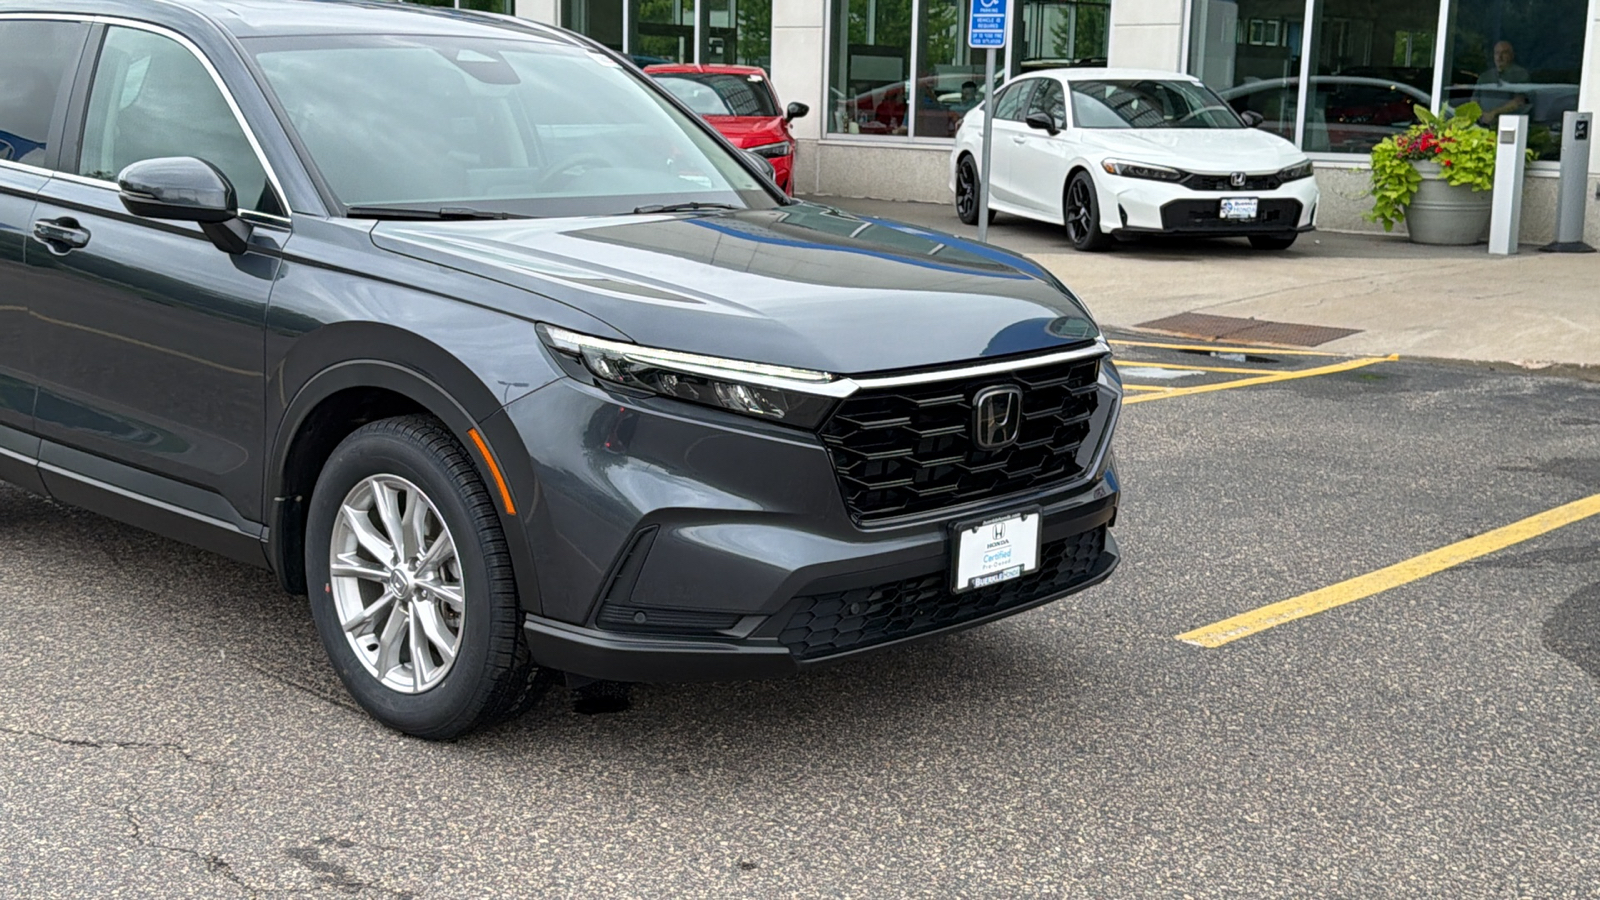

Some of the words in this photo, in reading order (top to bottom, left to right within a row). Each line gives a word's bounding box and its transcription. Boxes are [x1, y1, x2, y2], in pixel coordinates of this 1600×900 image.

[986, 539, 1010, 549] HONDA
[983, 548, 1012, 563] Certified
[982, 559, 1011, 570] Pre-Owned
